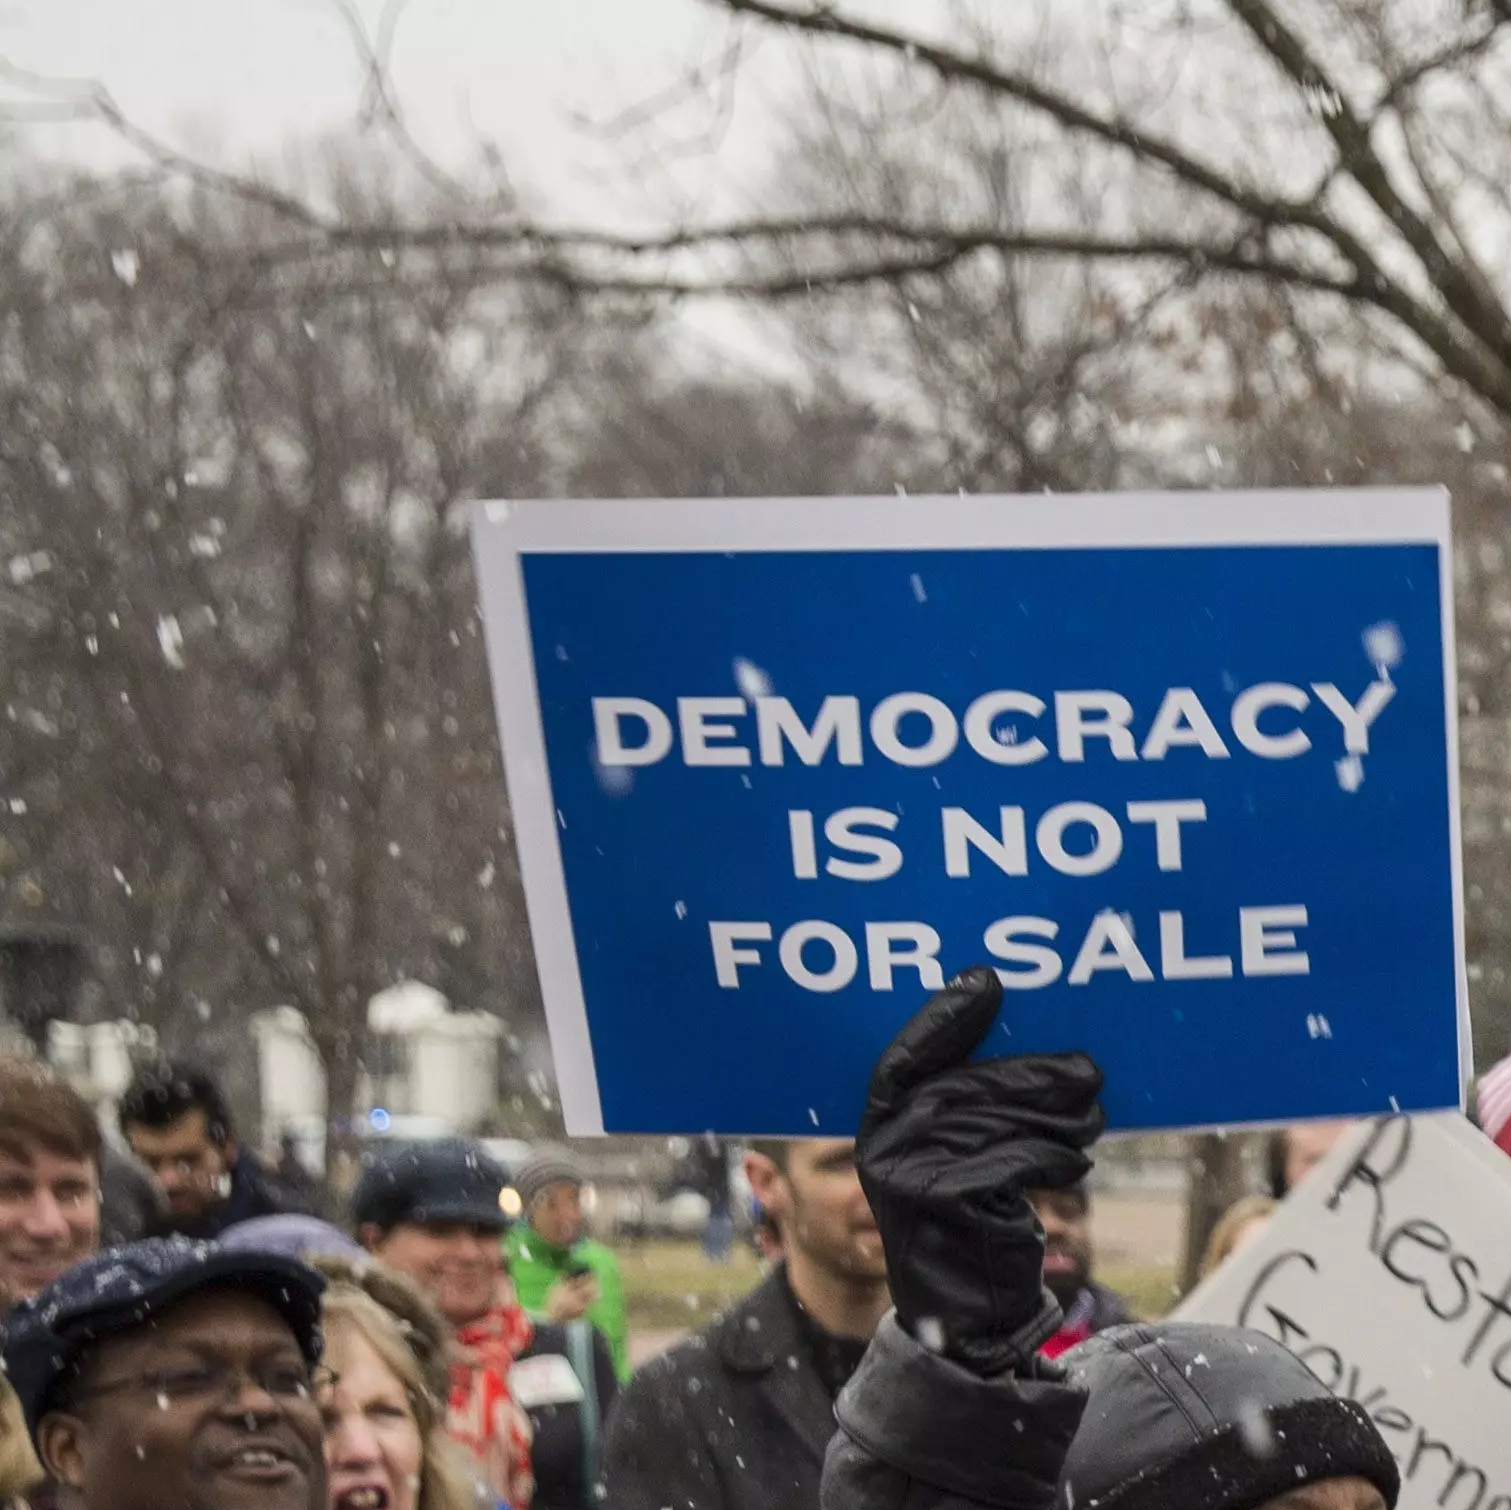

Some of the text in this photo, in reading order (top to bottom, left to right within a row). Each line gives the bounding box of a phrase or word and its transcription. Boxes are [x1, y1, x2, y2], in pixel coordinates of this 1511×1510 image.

[592, 682, 1394, 767] DEMOCRACY
[788, 800, 1206, 881] IS NOT
[708, 904, 1311, 993] FOR SALE
